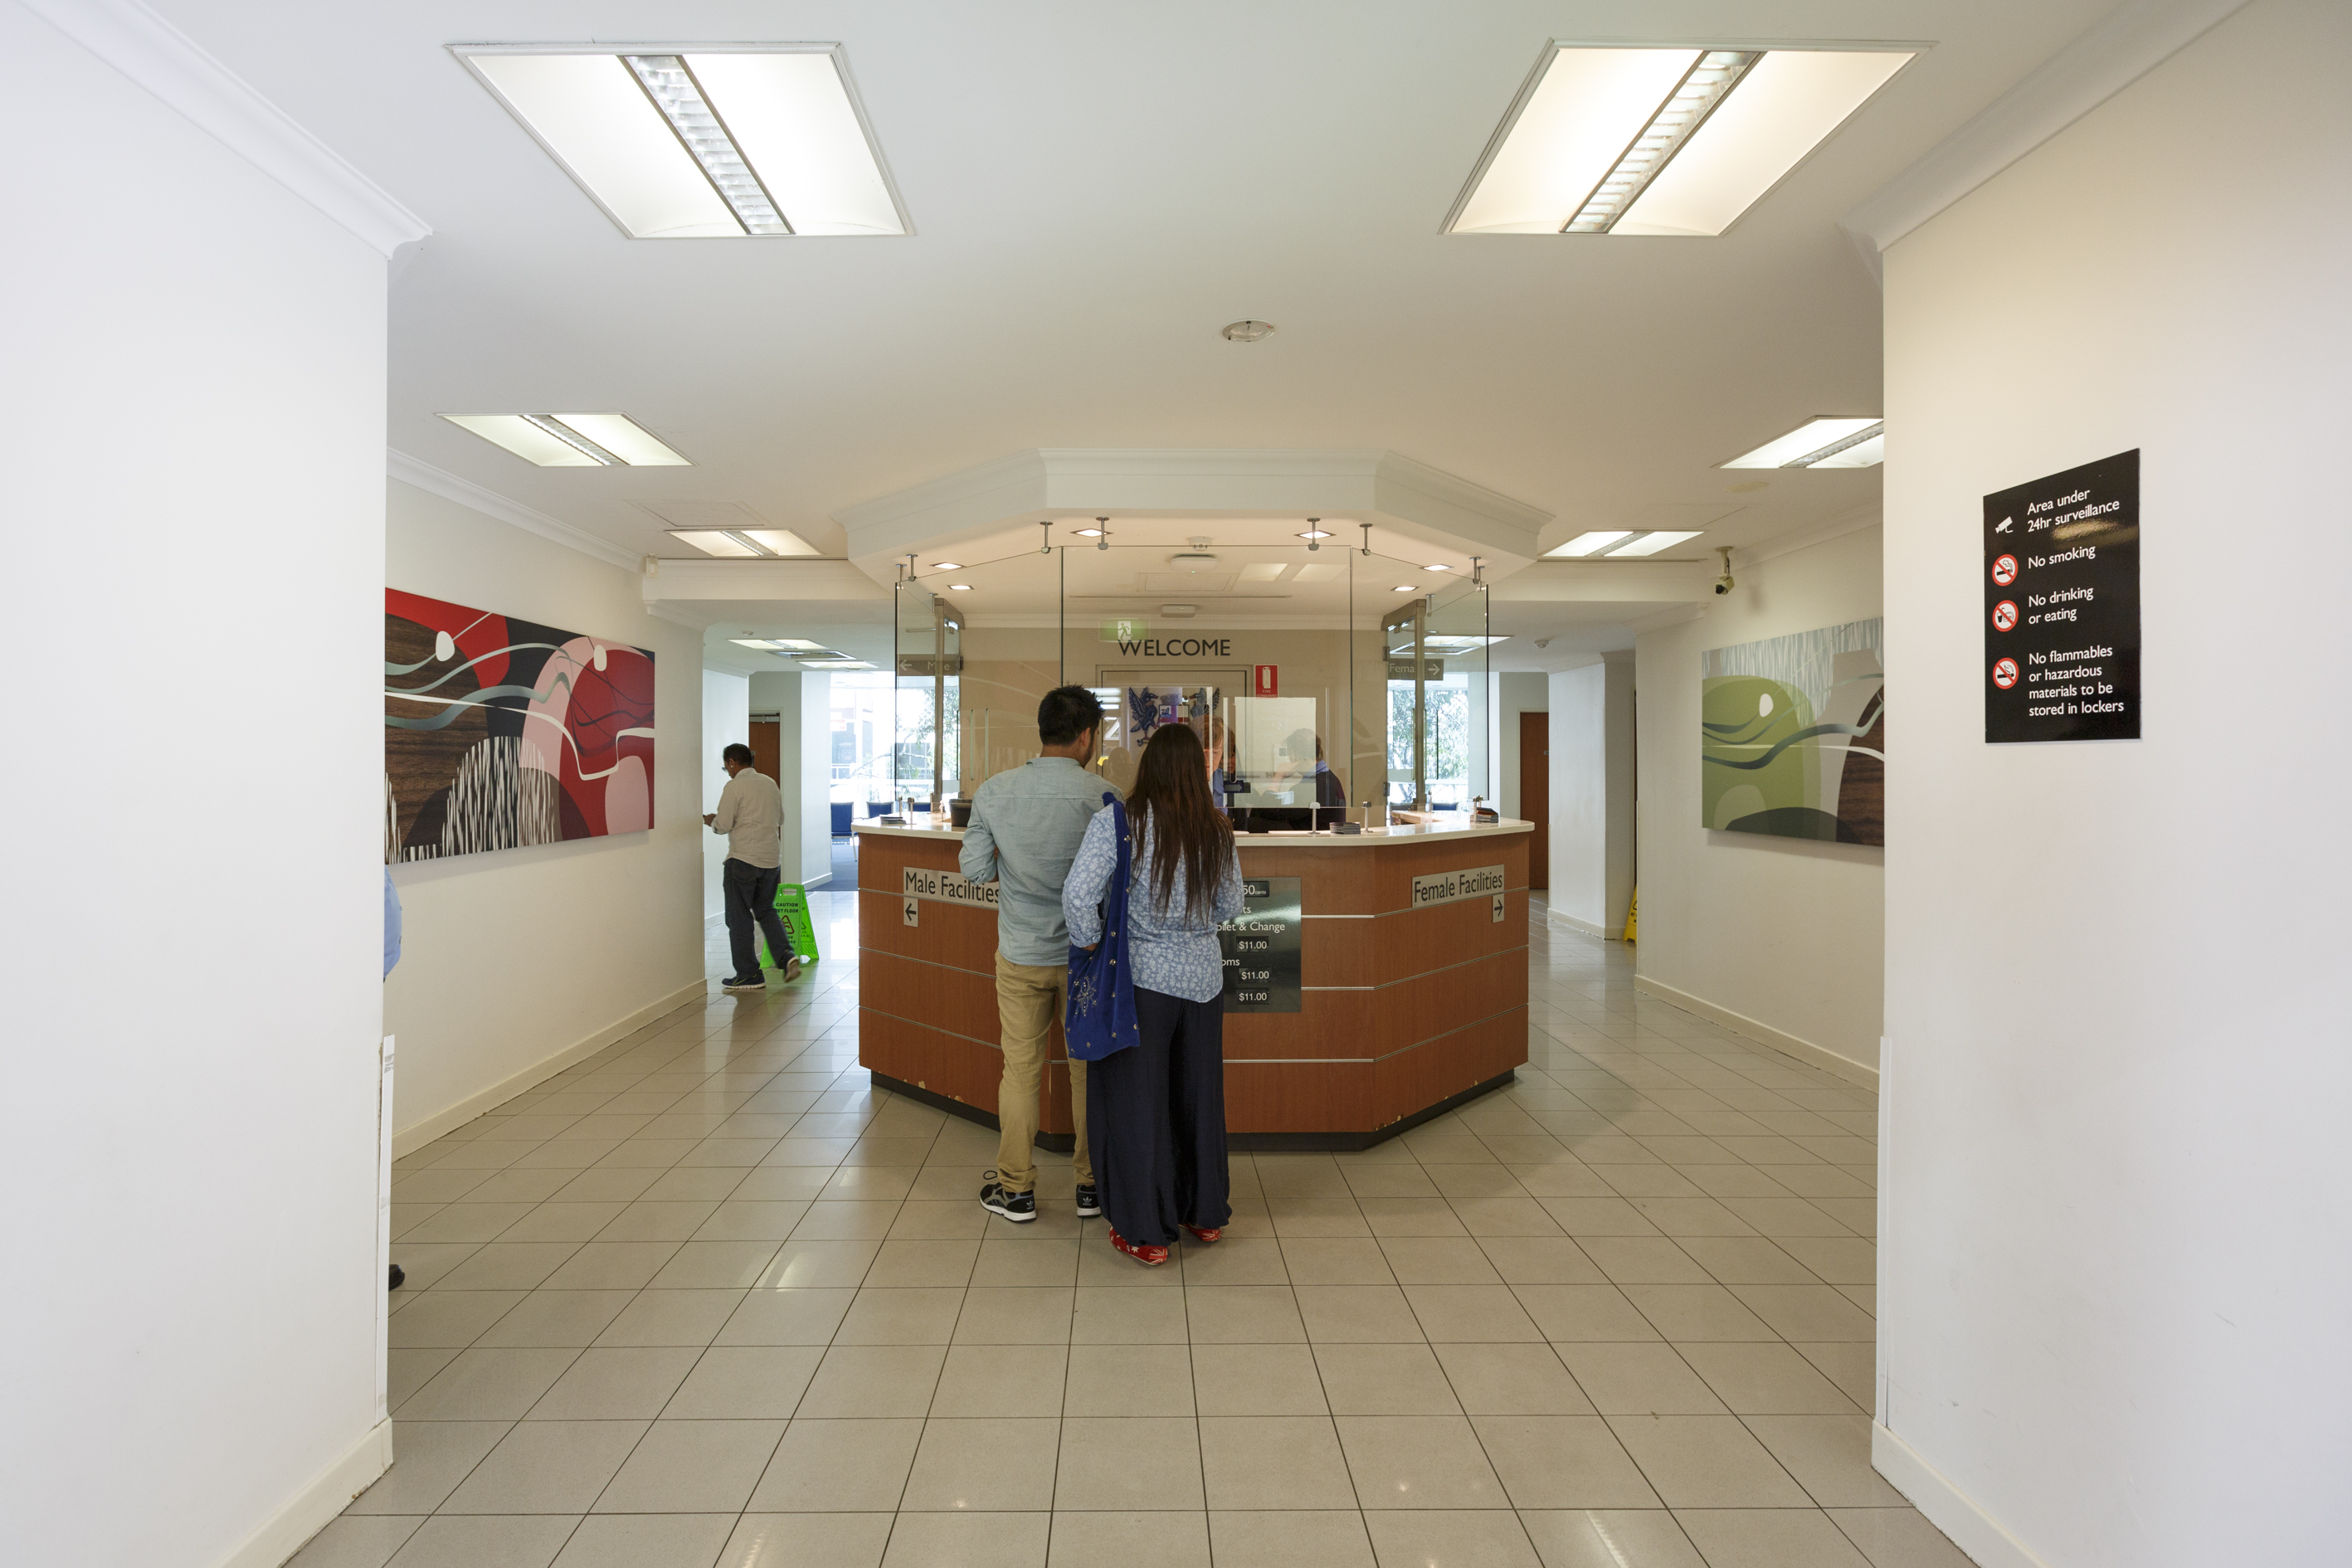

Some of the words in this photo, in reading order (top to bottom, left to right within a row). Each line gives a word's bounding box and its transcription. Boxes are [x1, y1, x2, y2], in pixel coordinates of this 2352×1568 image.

[2027, 500, 2053, 515] Area
[2057, 489, 2091, 507] under
[2027, 518, 2052, 533] 24hr
[2055, 500, 2120, 525] surveillance
[2028, 555, 2046, 569] No
[2048, 546, 2096, 564] smoking
[2028, 594, 2046, 608] No
[2049, 587, 2094, 604] drinking
[2028, 614, 2041, 625] or
[2044, 607, 2077, 621] eating
[1118, 639, 1231, 656] WELCOME
[2028, 652, 2046, 665] No
[2049, 645, 2113, 663] flammables
[928, 660, 951, 670] Me
[1389, 663, 1415, 673] Fema
[2028, 671, 2041, 682] or
[2044, 665, 2102, 681] hazardous
[2029, 684, 2077, 699] materials
[2081, 686, 2094, 695] to
[2098, 682, 2113, 694] be
[2028, 703, 2064, 717] stored
[2067, 703, 2077, 714] in
[2081, 700, 2125, 714] lockers
[906, 871, 936, 894] Male
[941, 875, 999, 903] Facilities
[1415, 877, 1455, 903] Female
[1459, 871, 1502, 894] Facilities
[1217, 921, 1236, 932] oilet
[1239, 922, 1247, 932] &
[1249, 921, 1286, 933] Change
[1239, 941, 1268, 950] $11.00
[1241, 971, 1269, 981] $11.00
[1239, 992, 1268, 1001] $11.00
